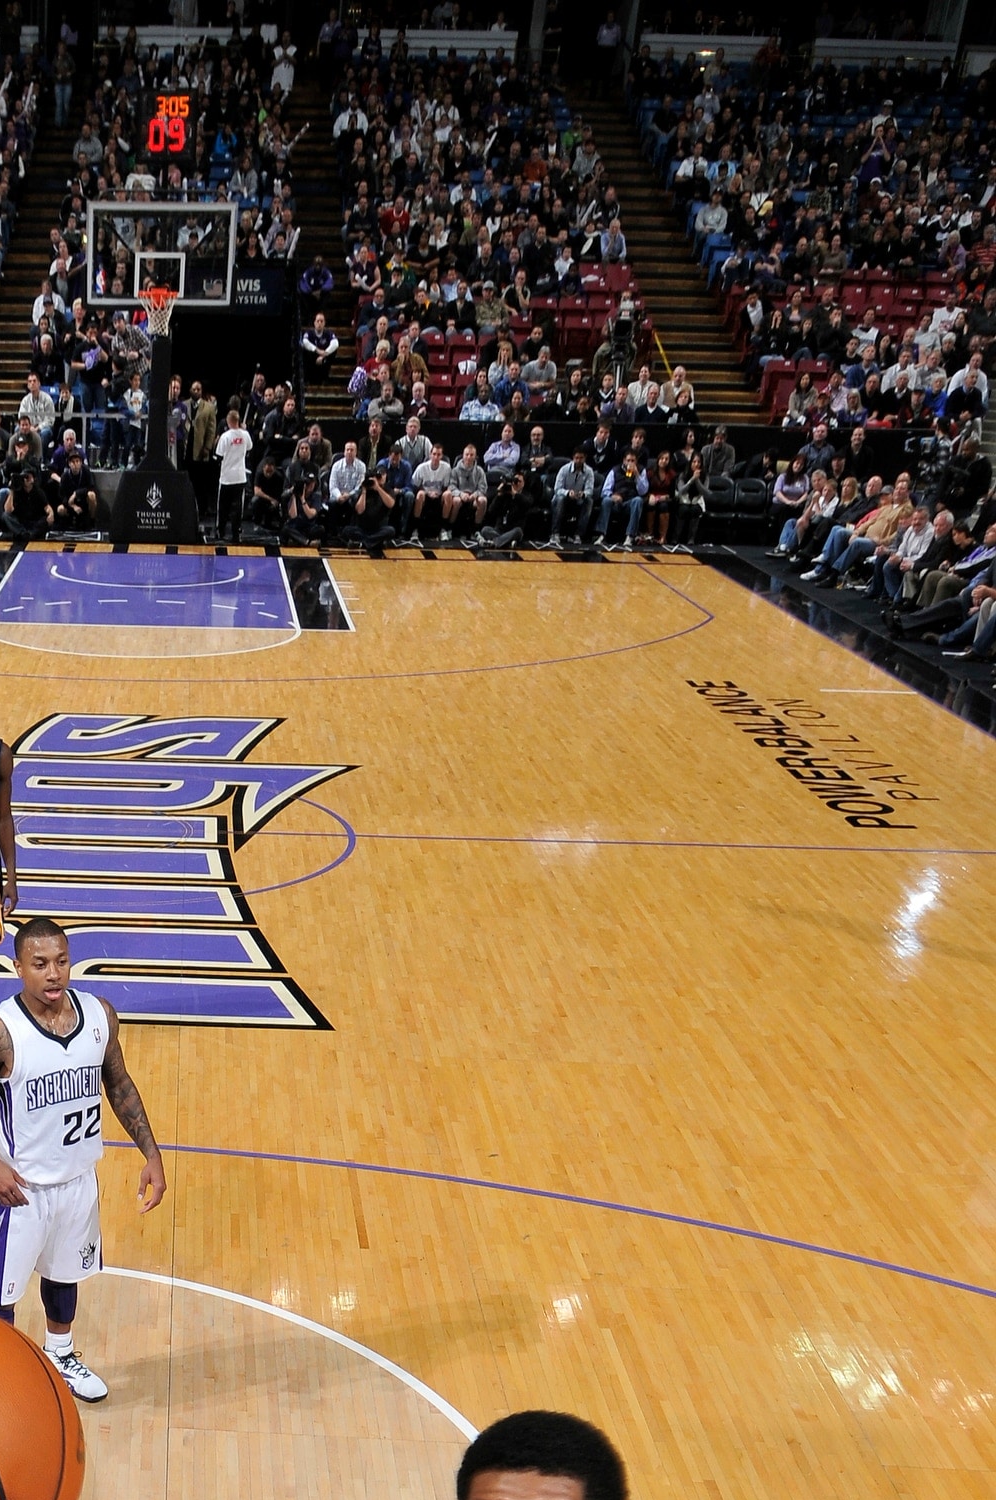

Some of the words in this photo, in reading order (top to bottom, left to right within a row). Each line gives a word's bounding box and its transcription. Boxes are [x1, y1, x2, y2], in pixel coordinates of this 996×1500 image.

[156, 95, 190, 118] 3:05
[148, 118, 185, 152] 09
[236, 279, 261, 292] AVIS
[235, 295, 267, 304] YSTEM
[136, 511, 171, 519] THUNDER
[766, 698, 941, 801] PAVILION
[63, 1102, 101, 1146] 22
